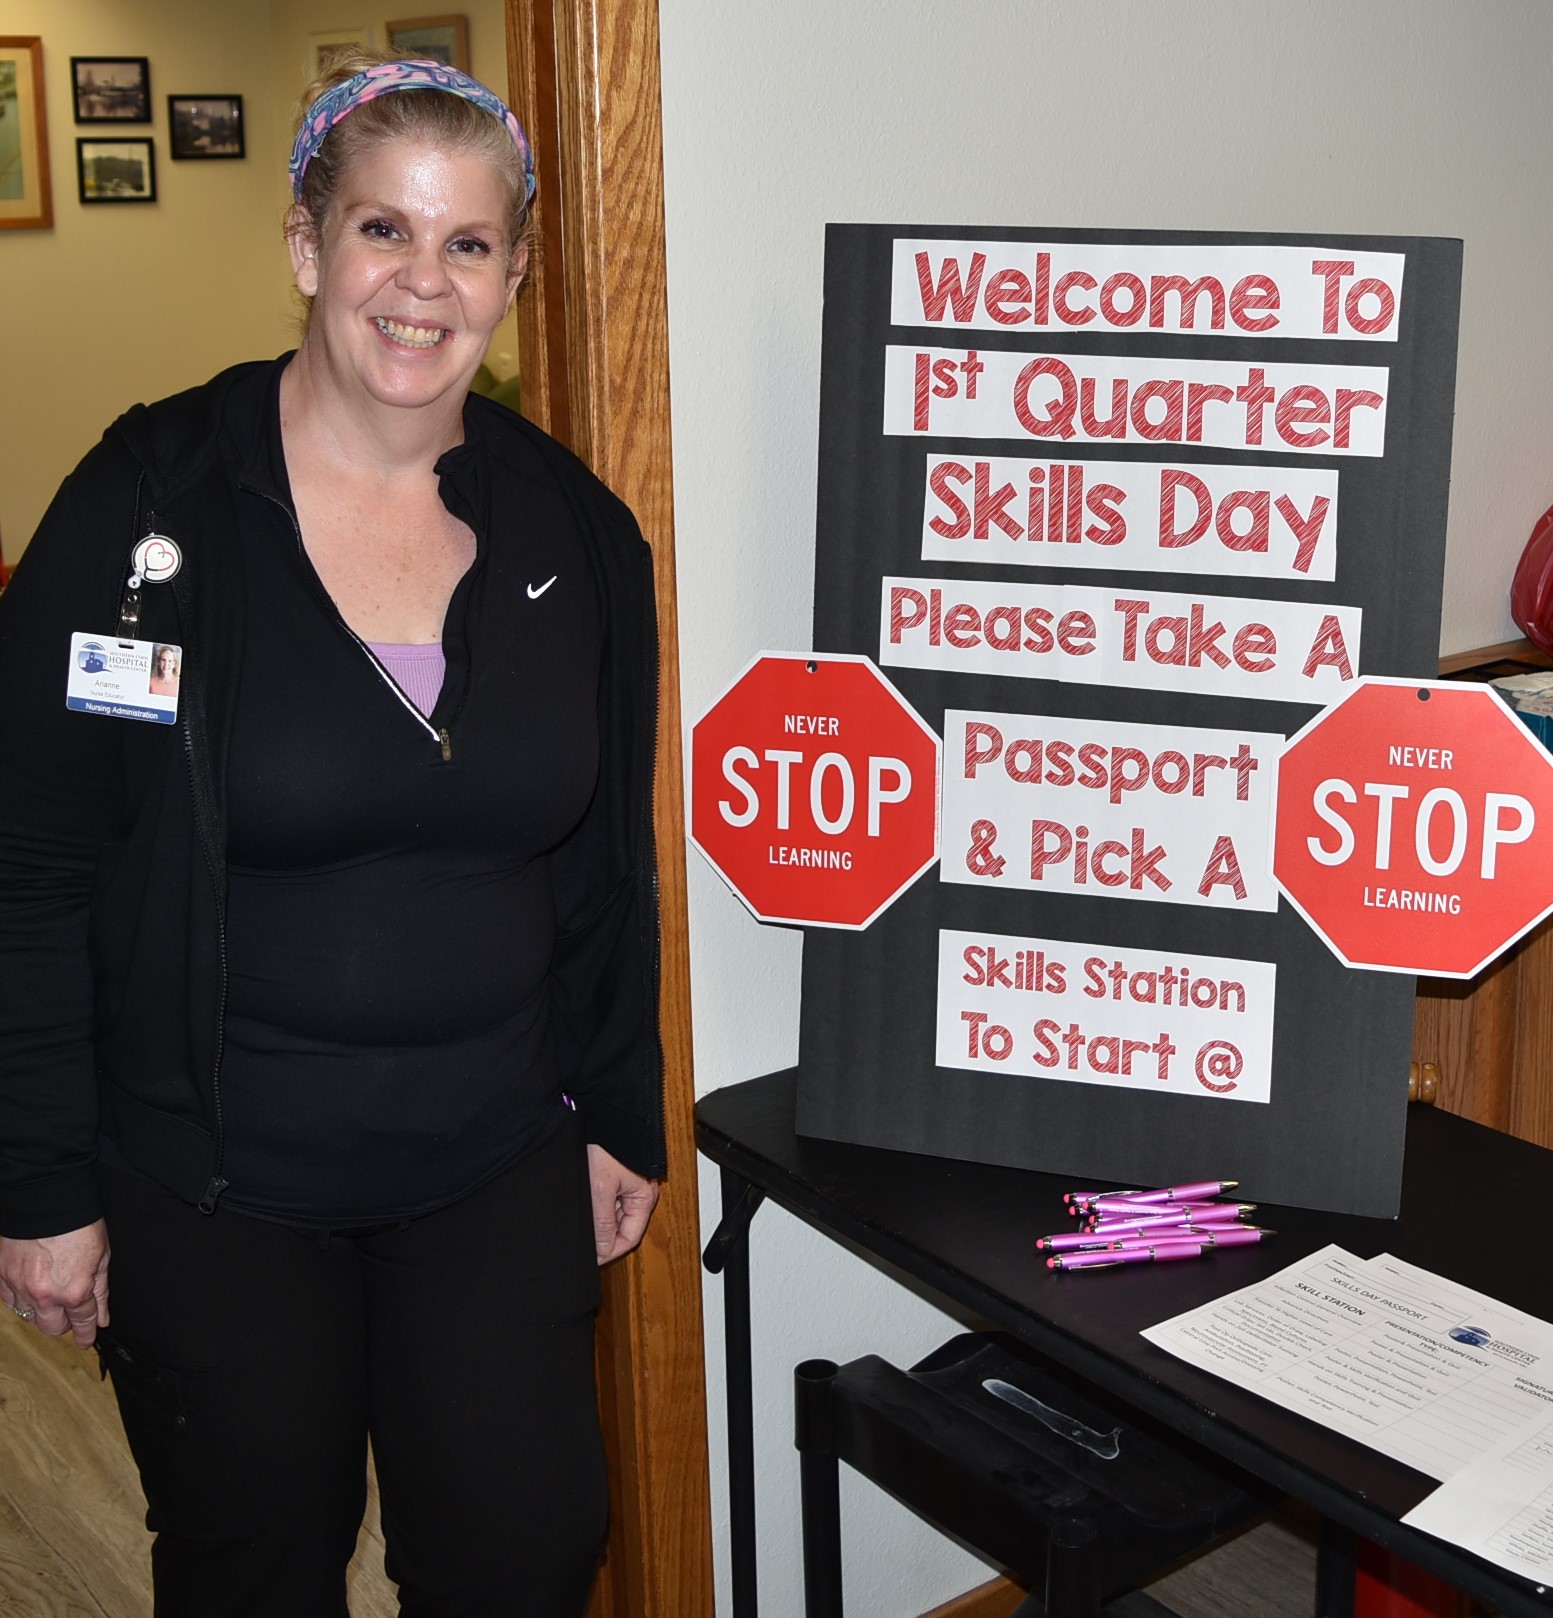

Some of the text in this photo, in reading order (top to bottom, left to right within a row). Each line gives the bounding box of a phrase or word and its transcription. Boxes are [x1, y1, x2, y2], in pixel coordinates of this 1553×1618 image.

[914, 251, 1395, 335] Welcome To
[913, 350, 1384, 448] 1st Quarter
[928, 461, 1330, 573] Skills Day
[890, 586, 1354, 683] Please Take A
[95, 680, 120, 689] Arianne
[109, 656, 148, 668] HOSPITAL
[85, 702, 158, 720] Nursing Administration
[105, 692, 125, 700] Educator
[784, 714, 839, 736] NEVER
[963, 721, 1258, 804] Passport
[1388, 745, 1454, 770] NEVER
[718, 745, 912, 837] STOP
[1306, 778, 1535, 880] STOP
[769, 846, 852, 870] LEARNING
[965, 819, 1248, 900] & Pick A
[1363, 886, 1461, 915] LEARNING
[962, 945, 1246, 1013] Skills Station
[961, 1010, 1244, 1092] To Start @
[1292, 1282, 1367, 1316] SKILL STATION
[1328, 1276, 1429, 1321] SKILLS DAY PASSPORT
[1384, 1319, 1490, 1368] PRESENTATION/COMPETENCY
[1488, 1341, 1538, 1364] HOSPITAL
